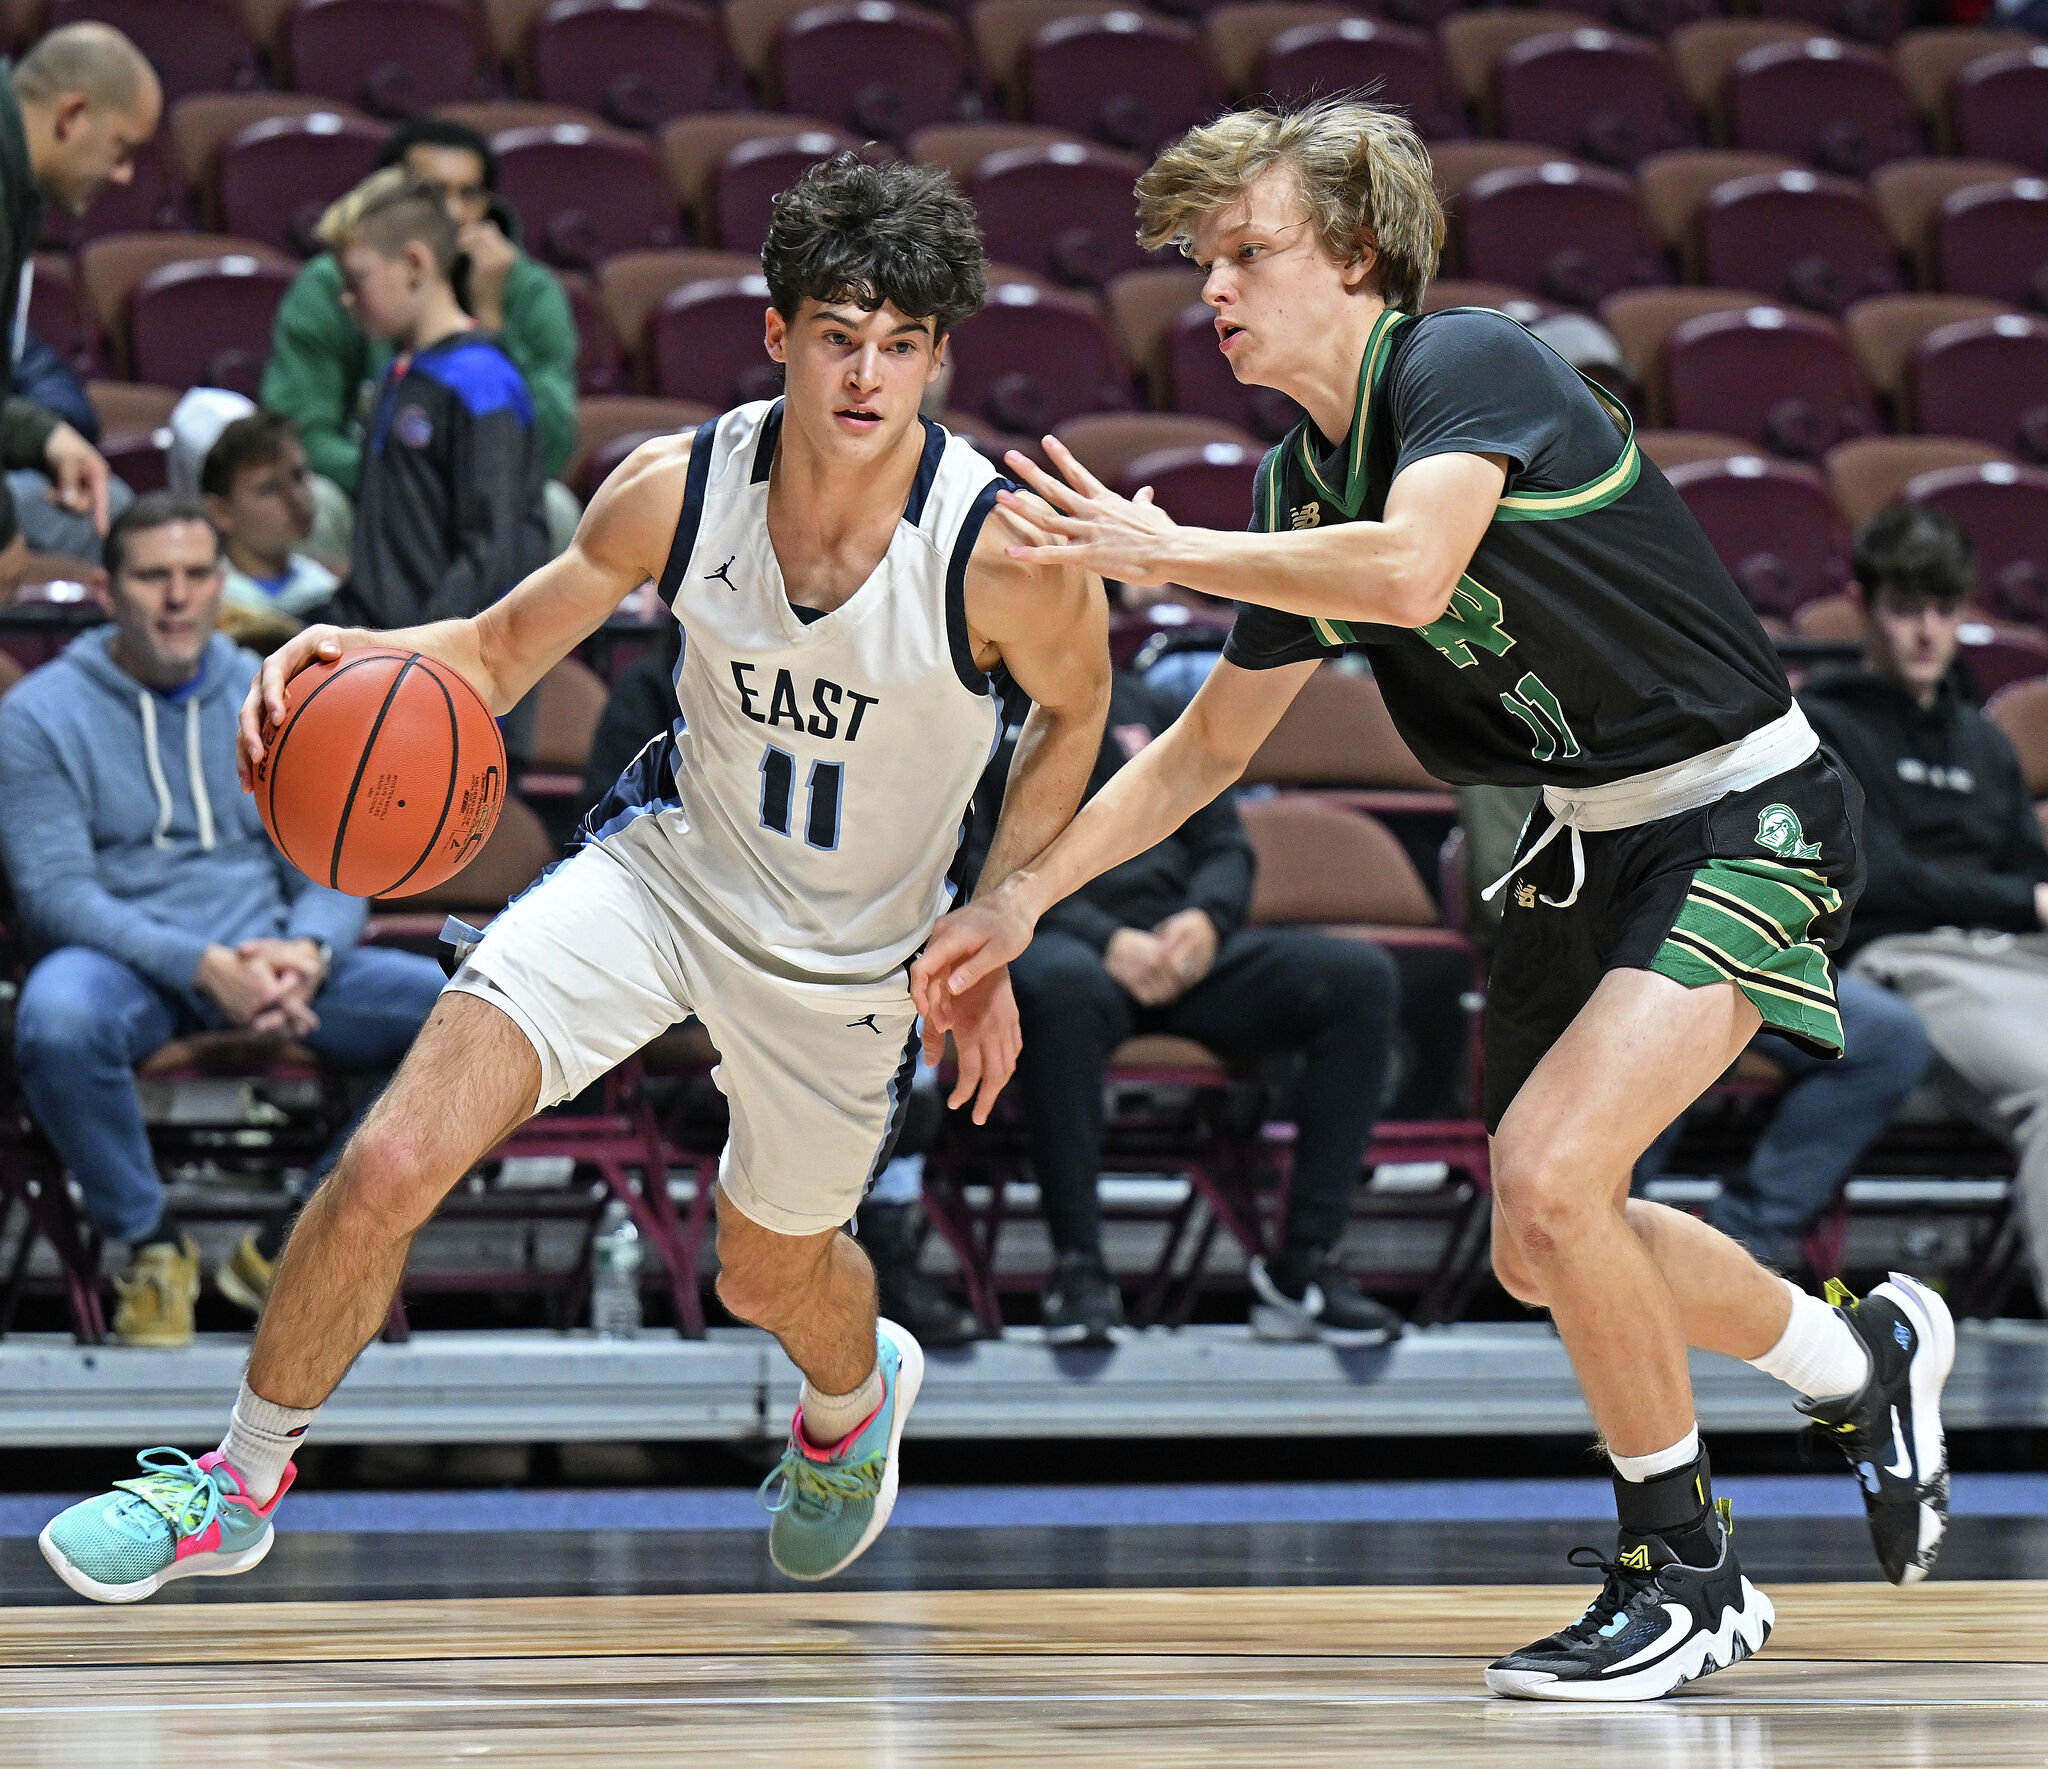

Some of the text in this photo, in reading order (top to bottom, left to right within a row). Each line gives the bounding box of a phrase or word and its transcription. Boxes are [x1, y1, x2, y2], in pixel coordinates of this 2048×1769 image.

[730, 660, 880, 741] EAST
[1500, 671, 1581, 761] 11
[758, 743, 845, 851] 11
